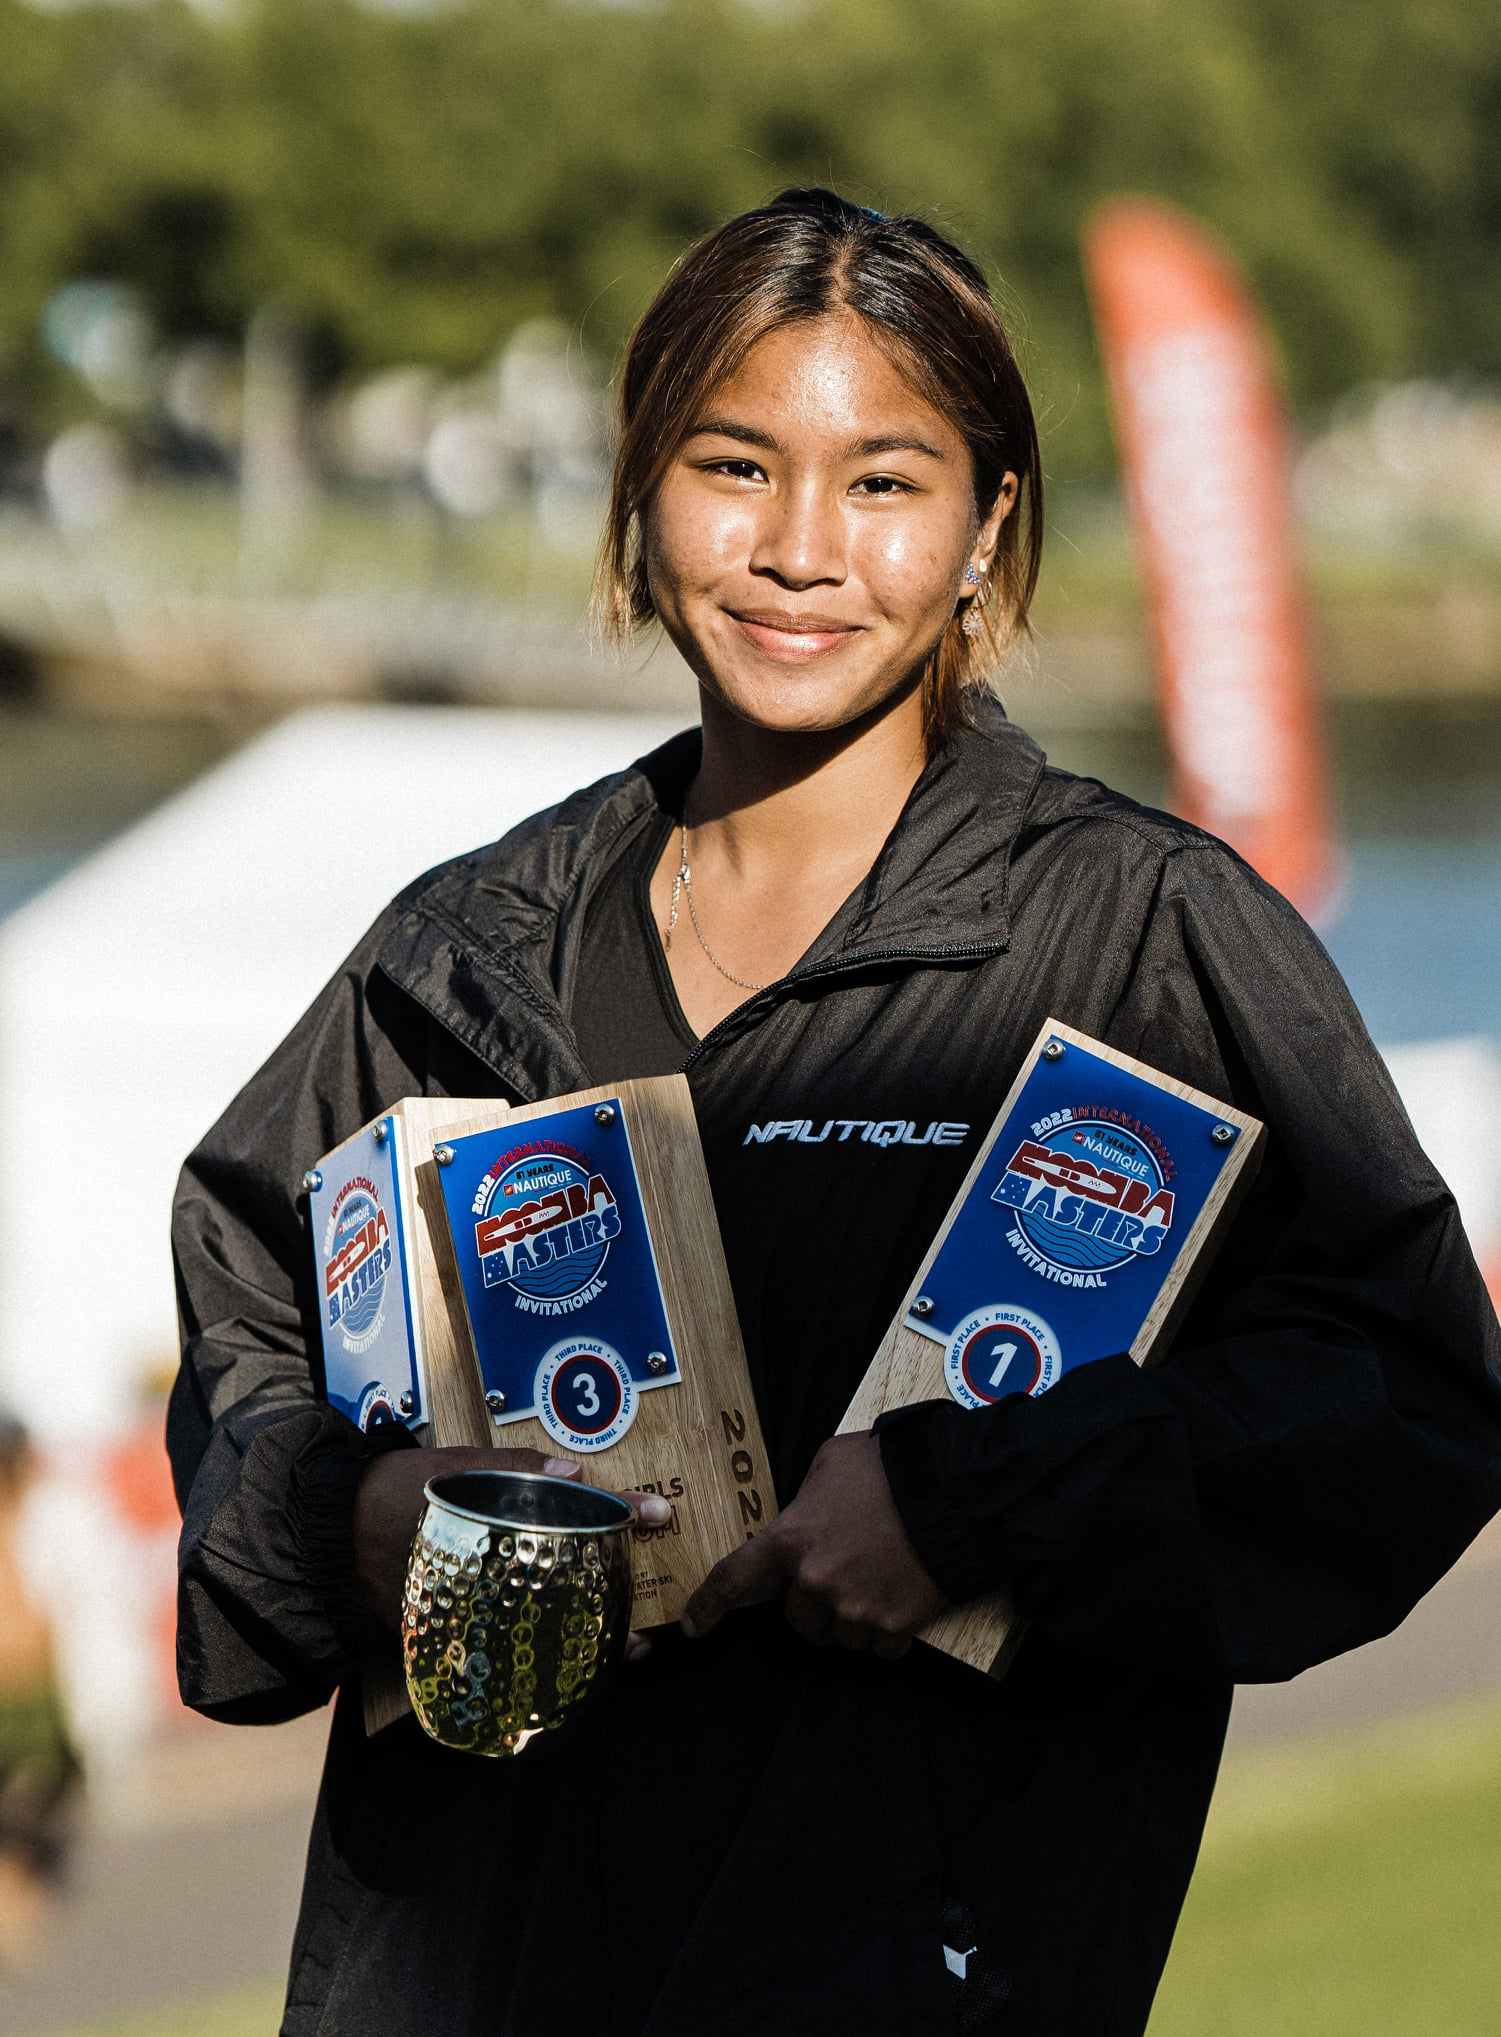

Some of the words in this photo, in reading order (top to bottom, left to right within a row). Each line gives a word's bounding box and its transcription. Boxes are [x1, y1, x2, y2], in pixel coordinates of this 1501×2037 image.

[742, 1119, 970, 1148] NAUTIQUE
[1030, 1108, 1073, 1137] 2022
[1072, 1105, 1178, 1182] INTERNATIONAL
[1106, 1135, 1138, 1156] YEARS
[526, 1163, 554, 1177] YEARS
[1083, 1136, 1149, 1177] NAUTIQUE
[472, 1174, 495, 1215] 2022
[488, 1140, 592, 1181] INTERNATIONAL
[513, 1169, 572, 1195] NAUTIQUE
[341, 1204, 370, 1233] NAUTIQUE
[990, 1170, 1168, 1256] MASTERS
[482, 1204, 621, 1288] MASTERS
[1005, 1228, 1107, 1288] INVITATIONAL
[328, 1238, 392, 1330] MASTERS
[515, 1278, 607, 1316] INVITATIONAL
[951, 1343, 962, 1369] FIRST
[957, 1319, 981, 1343] PLACE
[995, 1312, 1021, 1323] FIRST
[1021, 1318, 1045, 1342] PLACE
[555, 1344, 577, 1362] THIRD
[578, 1343, 603, 1354] PLACE
[988, 1342, 1018, 1388] 1
[1044, 1355, 1053, 1382] FIRST
[541, 1373, 551, 1401] PLACE
[572, 1373, 600, 1416] 3
[614, 1359, 629, 1385] THIRD
[622, 1387, 632, 1415] PLACE
[543, 1403, 558, 1429] THIRD
[569, 1434, 594, 1446] PLACE
[595, 1427, 617, 1445] THIRD
[720, 1409, 764, 1541] 202
[635, 1577, 658, 1591] ATER
